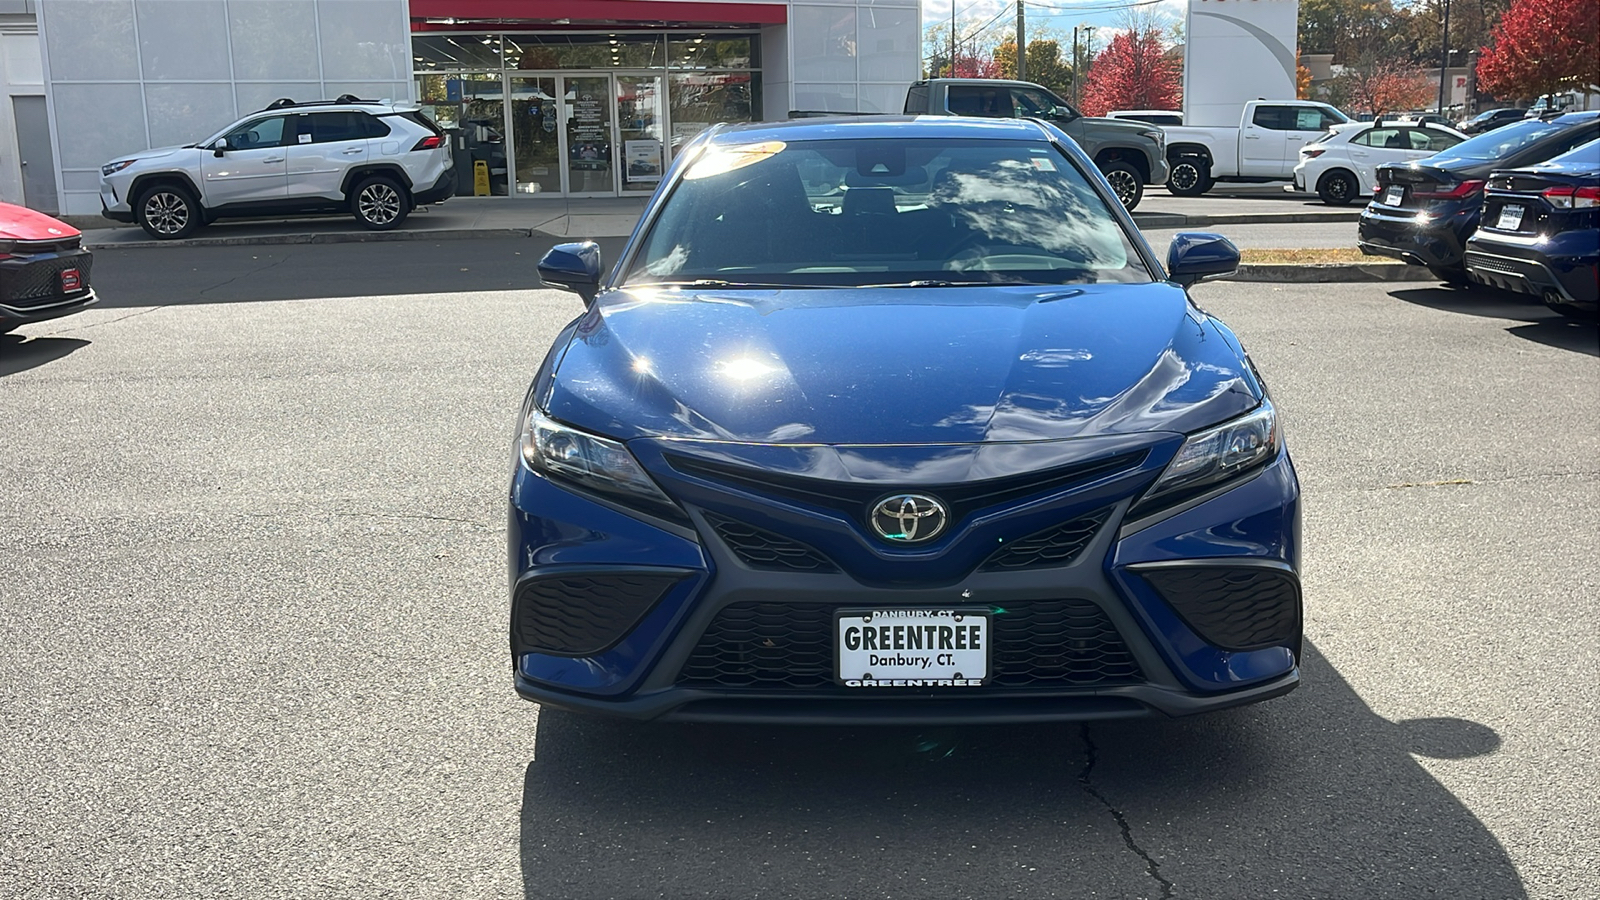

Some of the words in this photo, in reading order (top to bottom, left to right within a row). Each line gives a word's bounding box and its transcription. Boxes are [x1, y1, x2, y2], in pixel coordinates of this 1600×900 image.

[937, 610, 955, 618] CT
[845, 626, 980, 650] GREENTREE
[869, 653, 933, 669] Danbury,
[936, 654, 956, 666] CT.
[845, 679, 982, 687] GREENTREE
